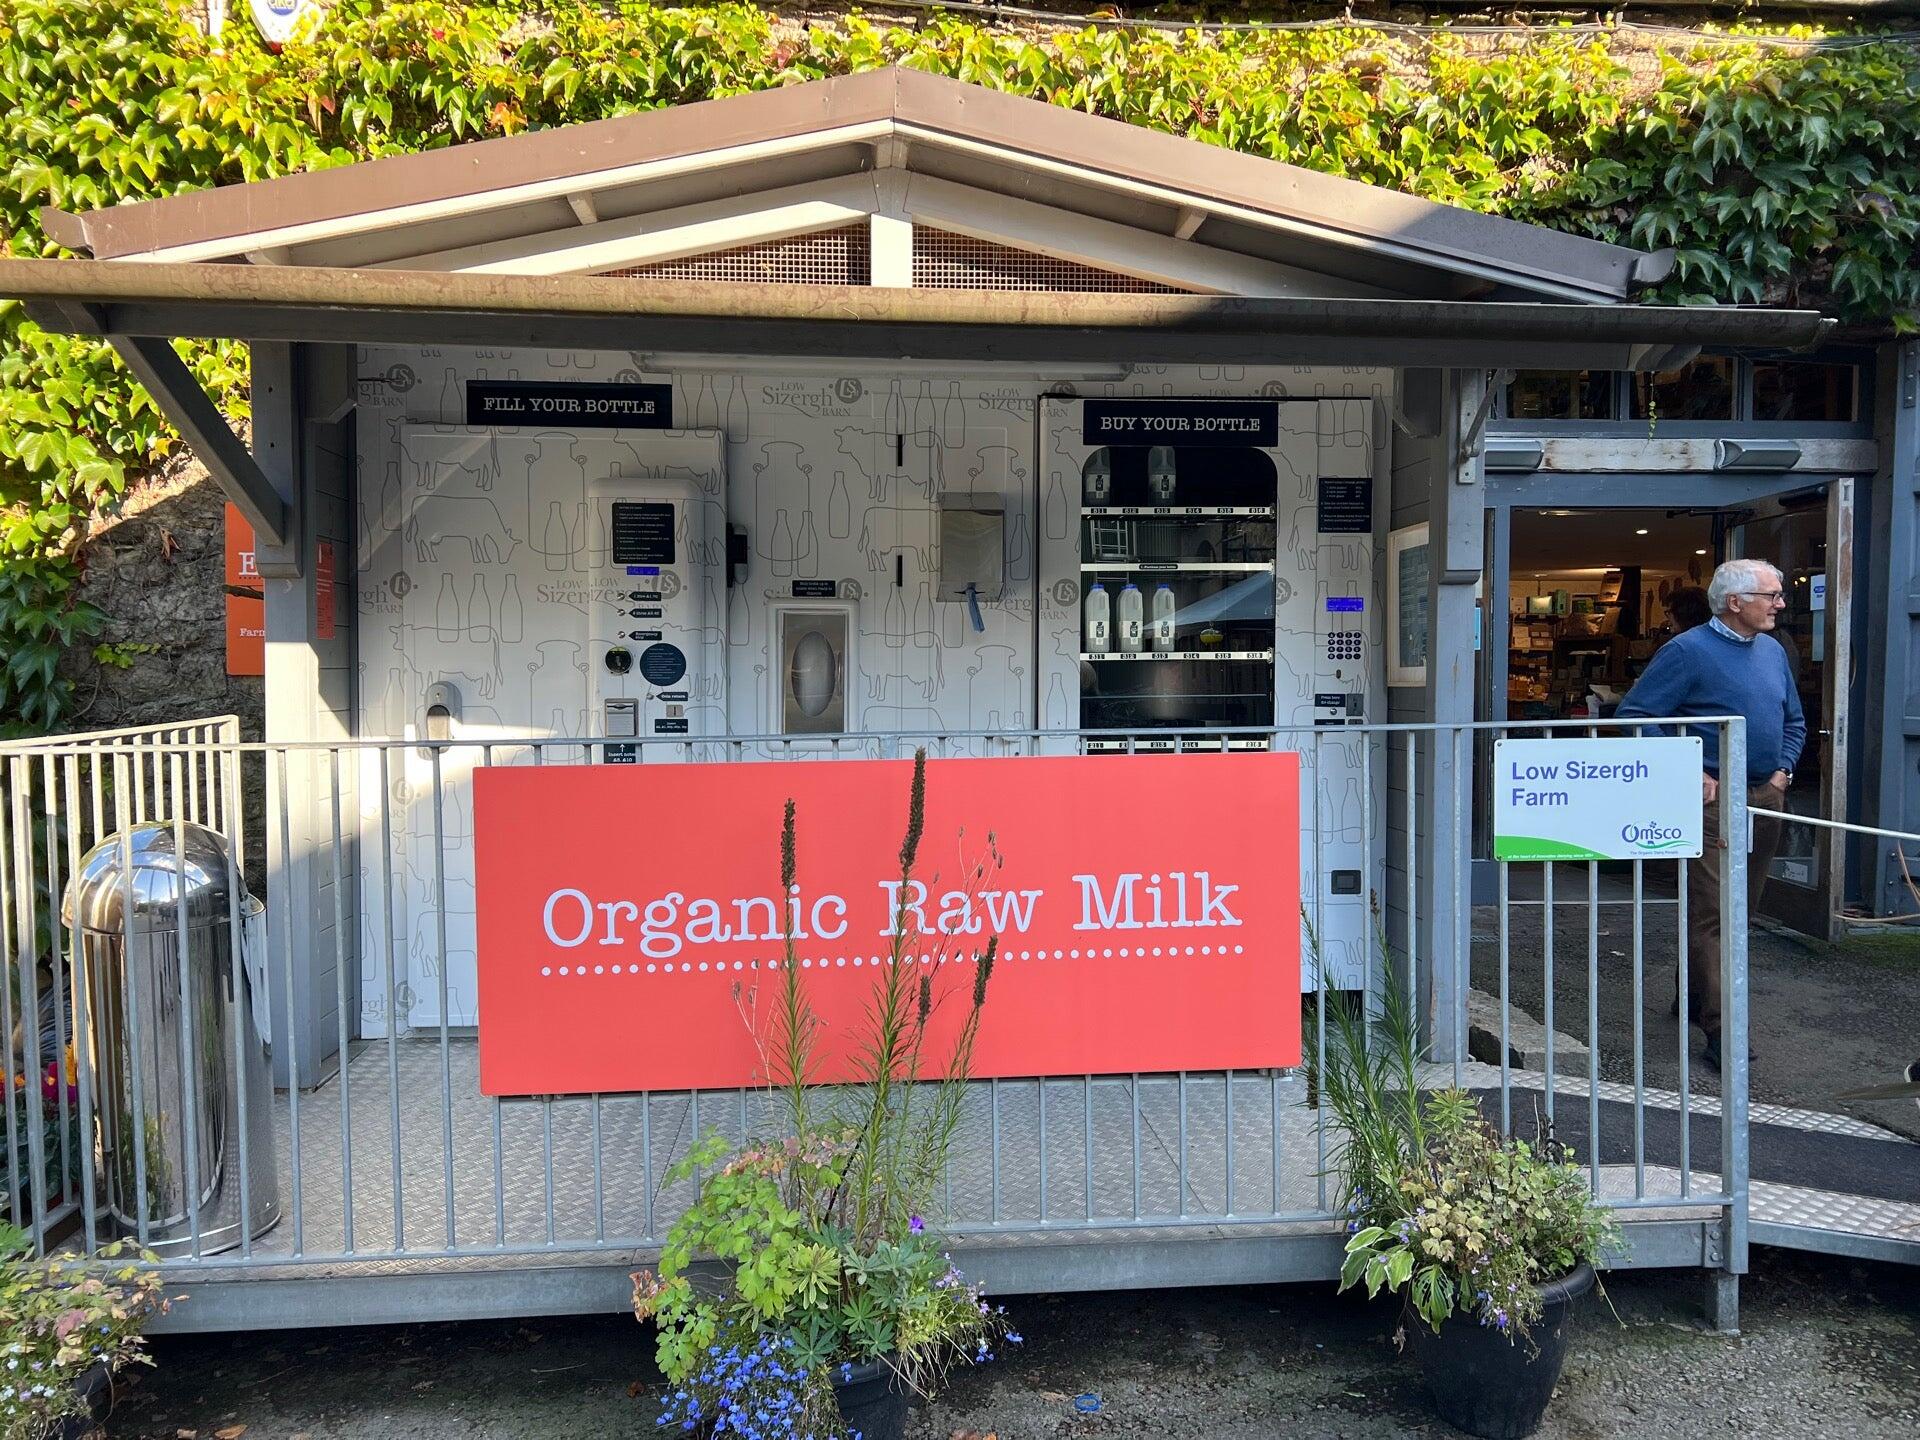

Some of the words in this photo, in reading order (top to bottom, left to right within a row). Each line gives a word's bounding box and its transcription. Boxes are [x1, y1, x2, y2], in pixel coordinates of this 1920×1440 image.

[484, 397, 524, 411] FILL
[529, 398, 581, 413] YOUR
[585, 399, 655, 414] BOTTLE
[762, 385, 832, 412] Sizergh
[1100, 417, 1136, 430] BUY
[1141, 417, 1190, 431] YOUR
[1193, 418, 1260, 431] BOTTLE
[1512, 762, 1558, 780] Low
[1566, 760, 1648, 782] Sizergh
[1512, 788, 1568, 806] Farm
[1621, 823, 1682, 843] Omsco
[541, 882, 849, 958] Organic
[879, 879, 1043, 938] Raw
[1072, 870, 1243, 931] Milk
